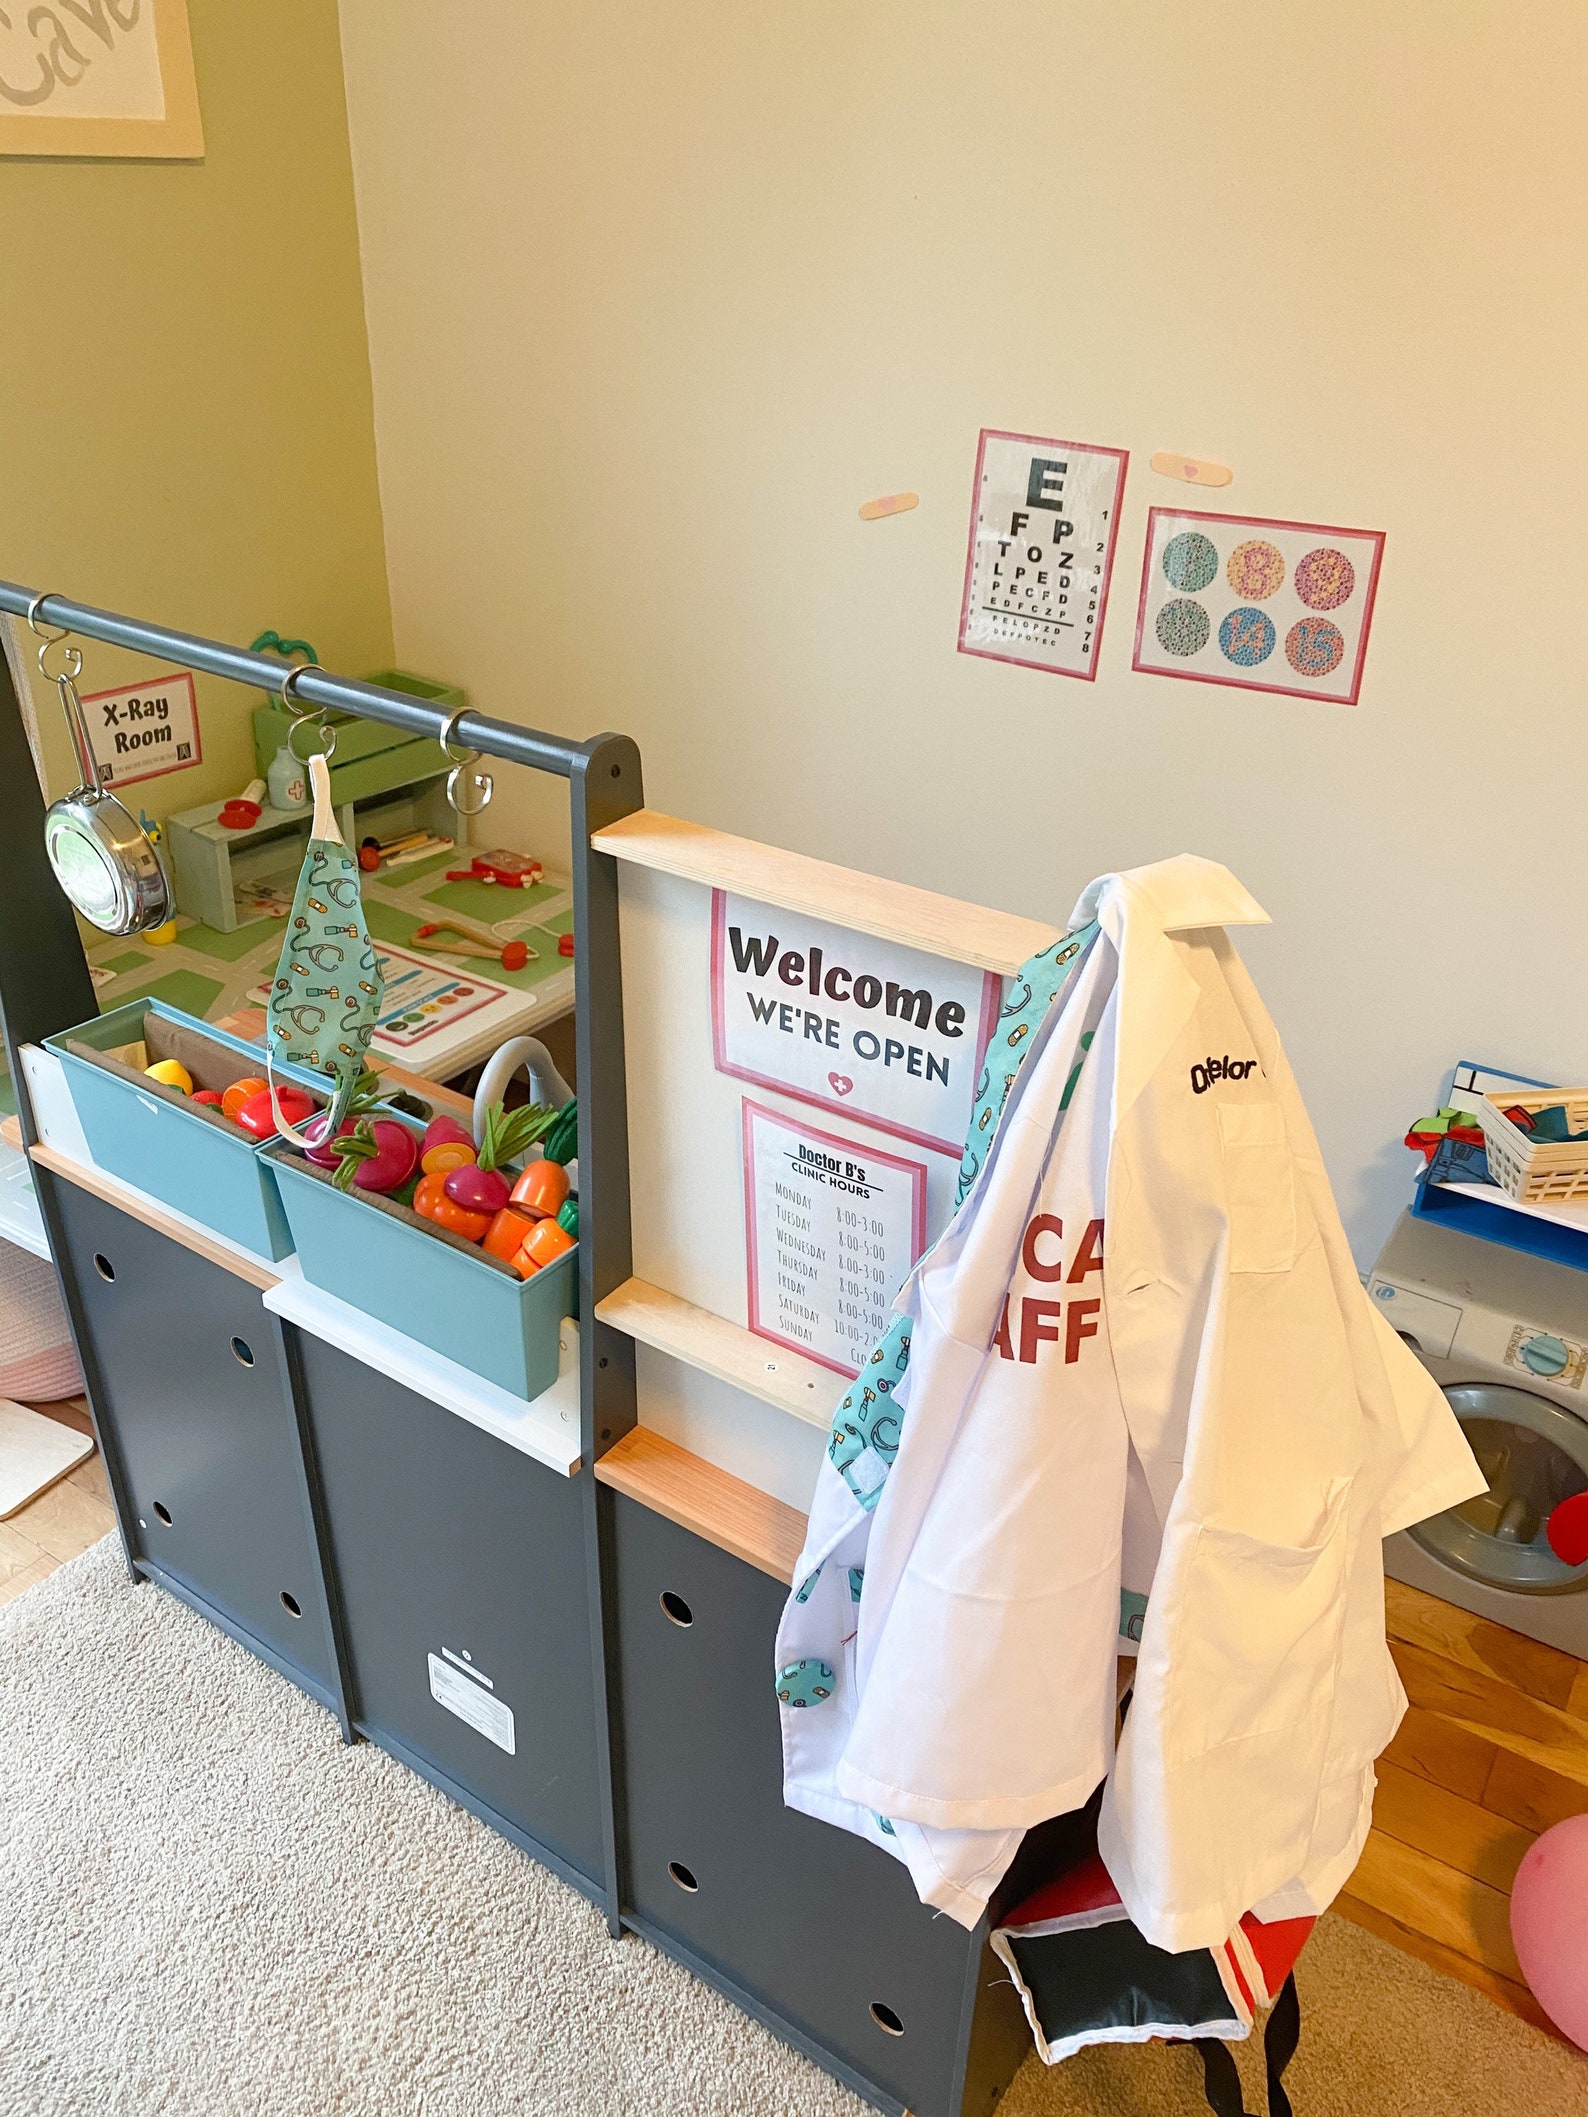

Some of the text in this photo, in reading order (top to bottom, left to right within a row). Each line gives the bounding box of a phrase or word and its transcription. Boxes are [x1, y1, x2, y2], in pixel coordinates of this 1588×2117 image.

[1026, 457, 1068, 513] E
[103, 698, 169, 727] X-Ray
[114, 724, 172, 754] Room
[728, 926, 966, 1038] Welcome
[746, 991, 950, 1087] WE'RE OPEN
[791, 1162, 870, 1199] CLINIC HOURS
[799, 1143, 866, 1182] Doctor B's
[775, 1182, 884, 1238] MONDAY 8:00-3:00
[776, 1204, 885, 1262] TUESDAY 8:00-5:00
[776, 1227, 885, 1285] WEDNESDAY 8:00-3:00
[777, 1249, 885, 1308] THURSDAY 8:00-5:00
[778, 1293, 878, 1347] SATURDAY 10:00-2:0
[779, 1315, 813, 1343] SUNDAY
[837, 1299, 883, 1330] 8:00-5:00
